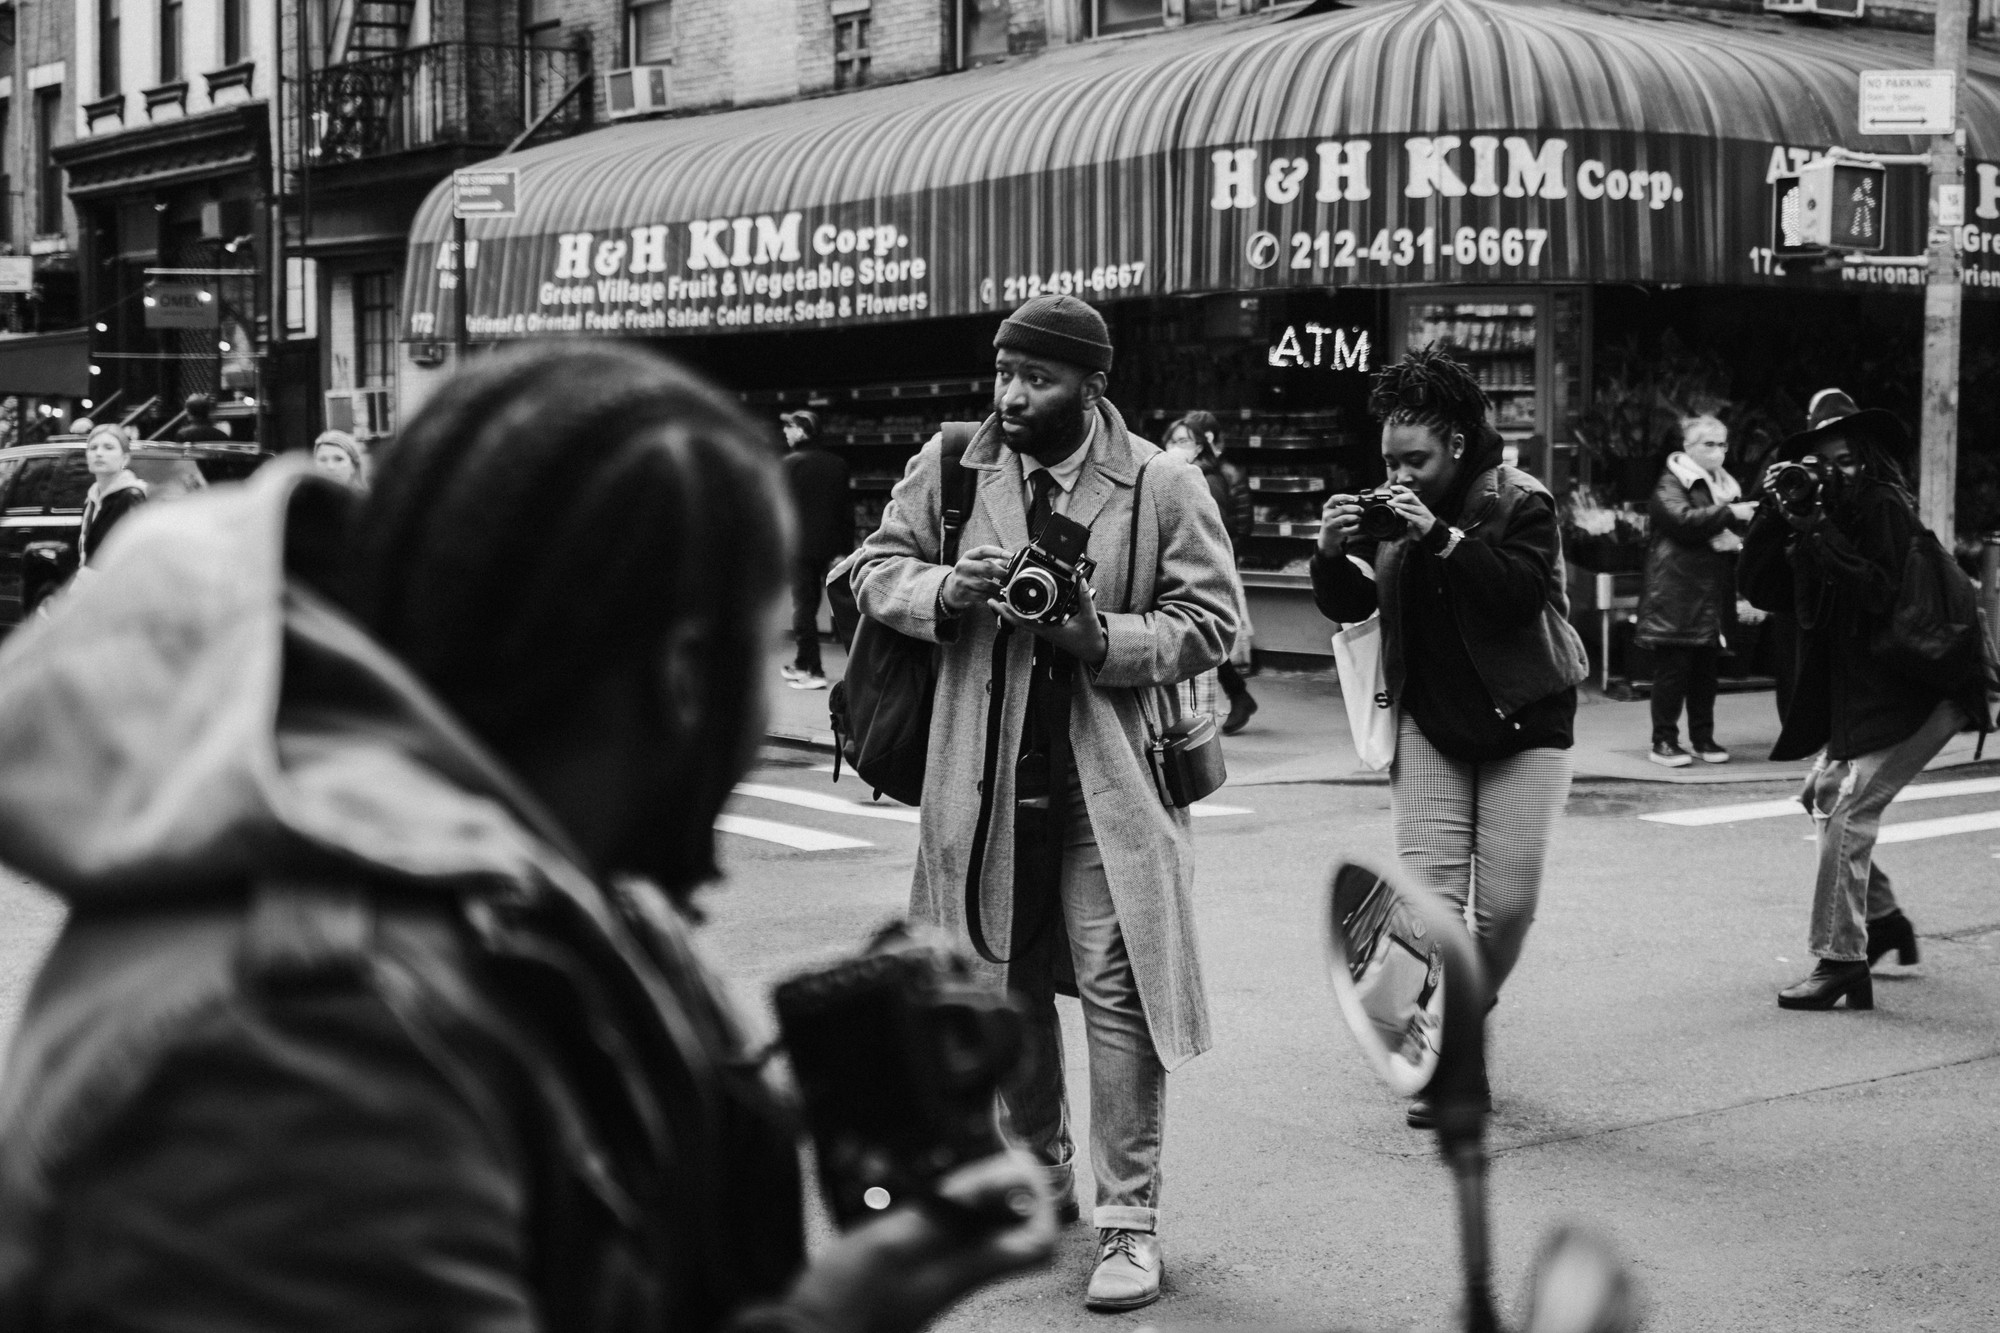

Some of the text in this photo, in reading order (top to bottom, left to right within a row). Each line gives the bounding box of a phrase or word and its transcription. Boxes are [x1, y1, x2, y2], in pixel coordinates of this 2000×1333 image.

[1867, 79, 1932, 89] NO PARKING
[1211, 135, 1683, 210] H&H KIM Corp.
[1766, 146, 1824, 184] AT
[554, 212, 909, 279] H&H KIM Corp.
[1290, 227, 1548, 267] 212-431-6667
[540, 256, 927, 307] Green Village Fruit & Vegetable Store
[1003, 262, 1146, 302] 212-431-6667
[716, 305, 750, 326] Cold
[838, 295, 852, 318] &
[856, 292, 928, 316] Flowers
[1269, 322, 1370, 372] ATM
